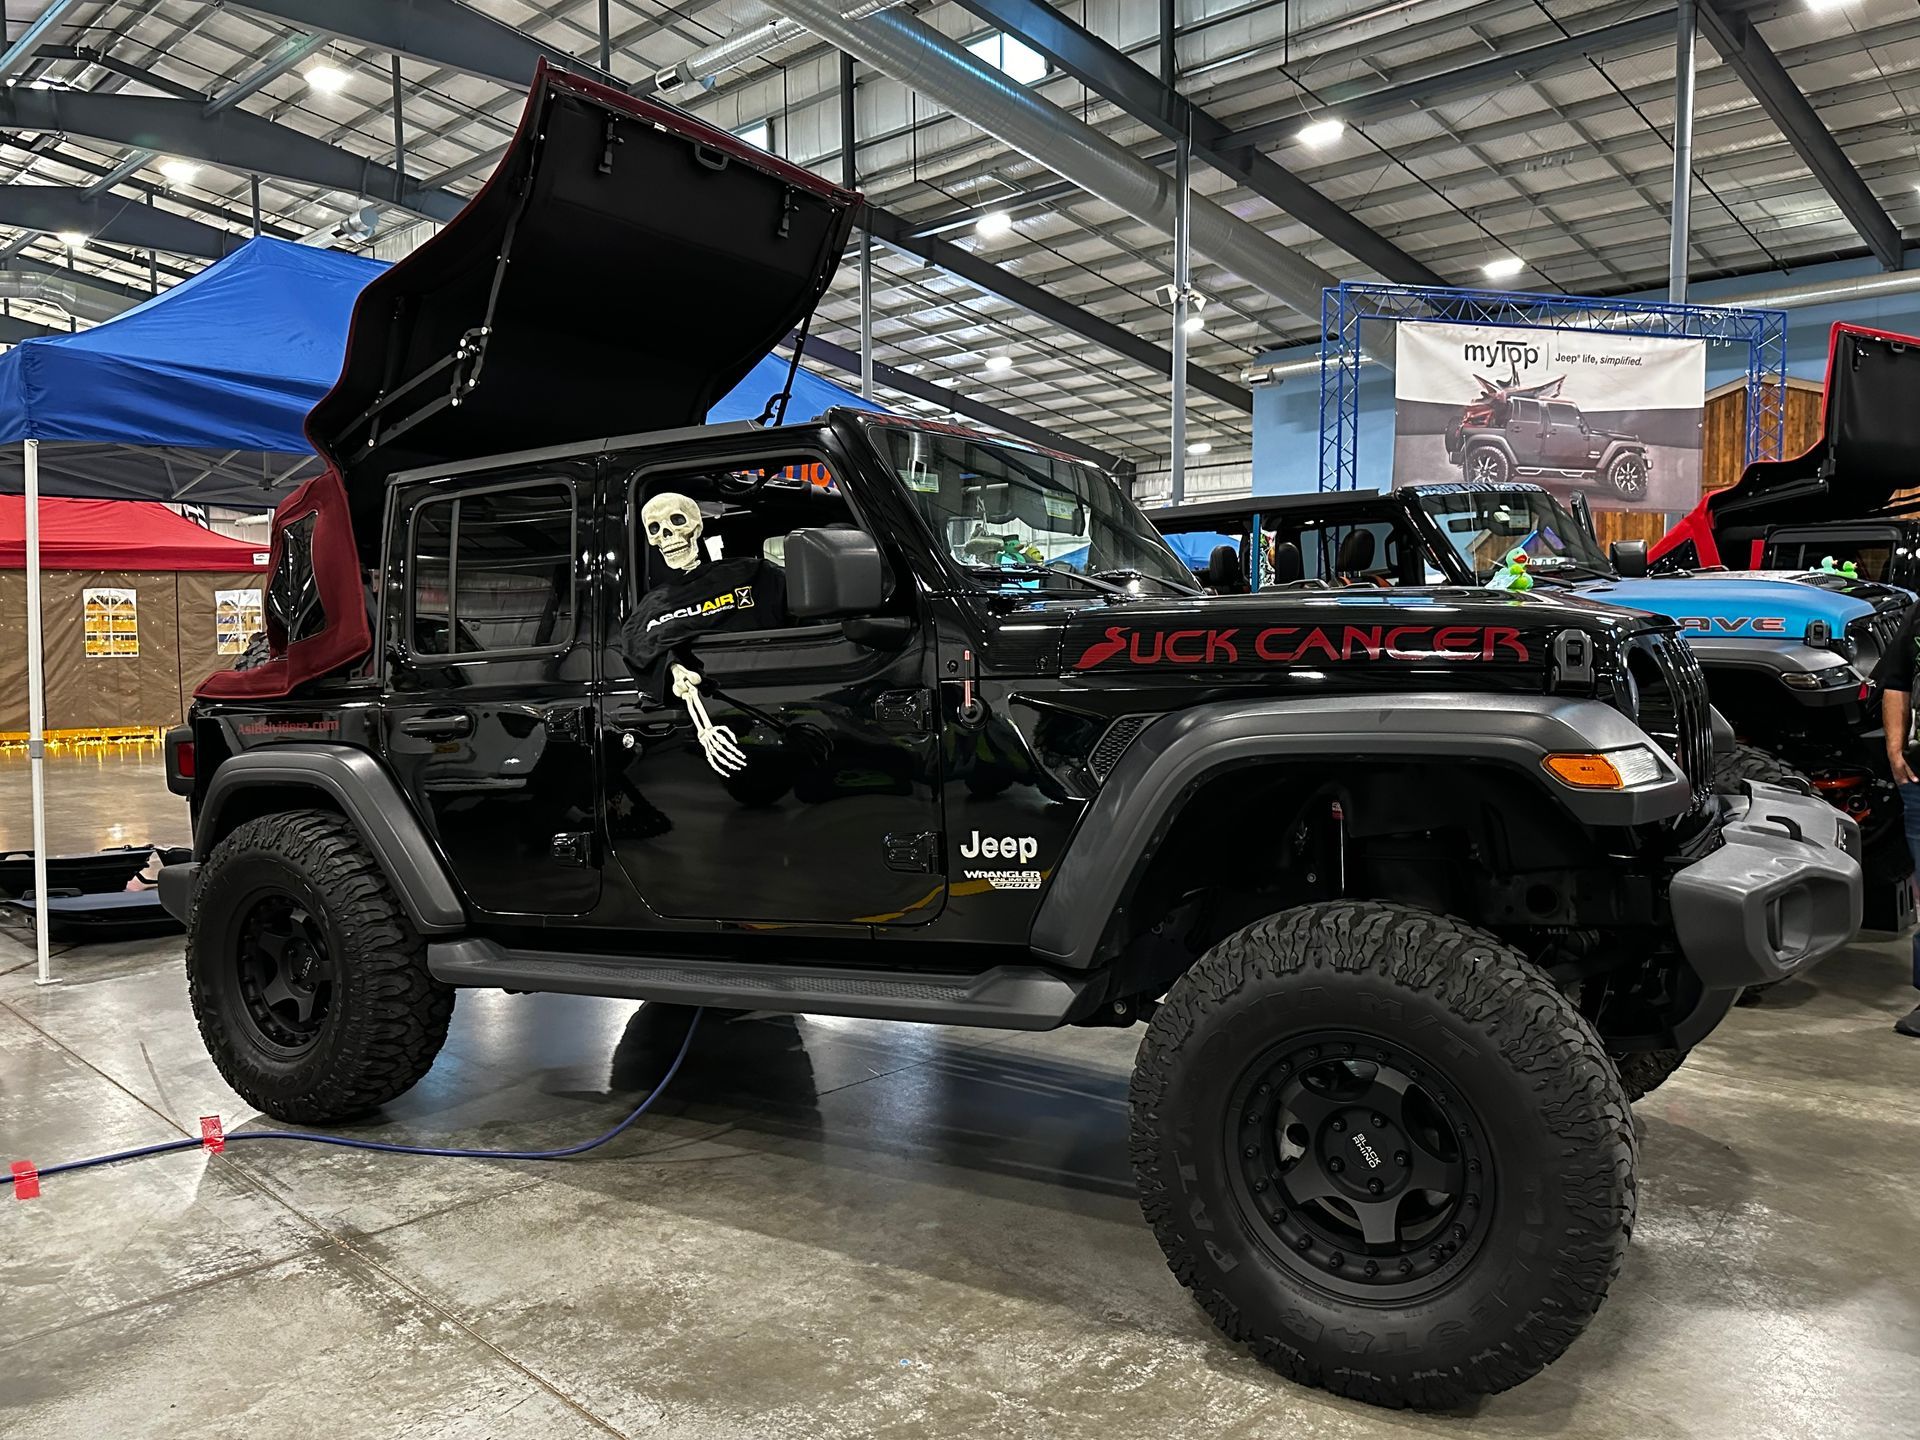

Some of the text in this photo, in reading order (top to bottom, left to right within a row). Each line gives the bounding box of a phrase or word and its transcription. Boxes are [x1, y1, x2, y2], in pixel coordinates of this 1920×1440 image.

[1600, 355, 1643, 367] simplified.
[646, 592, 735, 633] ACCUAIR
[1254, 626, 1529, 662] CANCER
[960, 830, 1038, 864] Jeep
[963, 870, 1041, 878] WRANGLER
[1352, 1136, 1377, 1169] RHINO
[1357, 1133, 1382, 1165] BLACK
